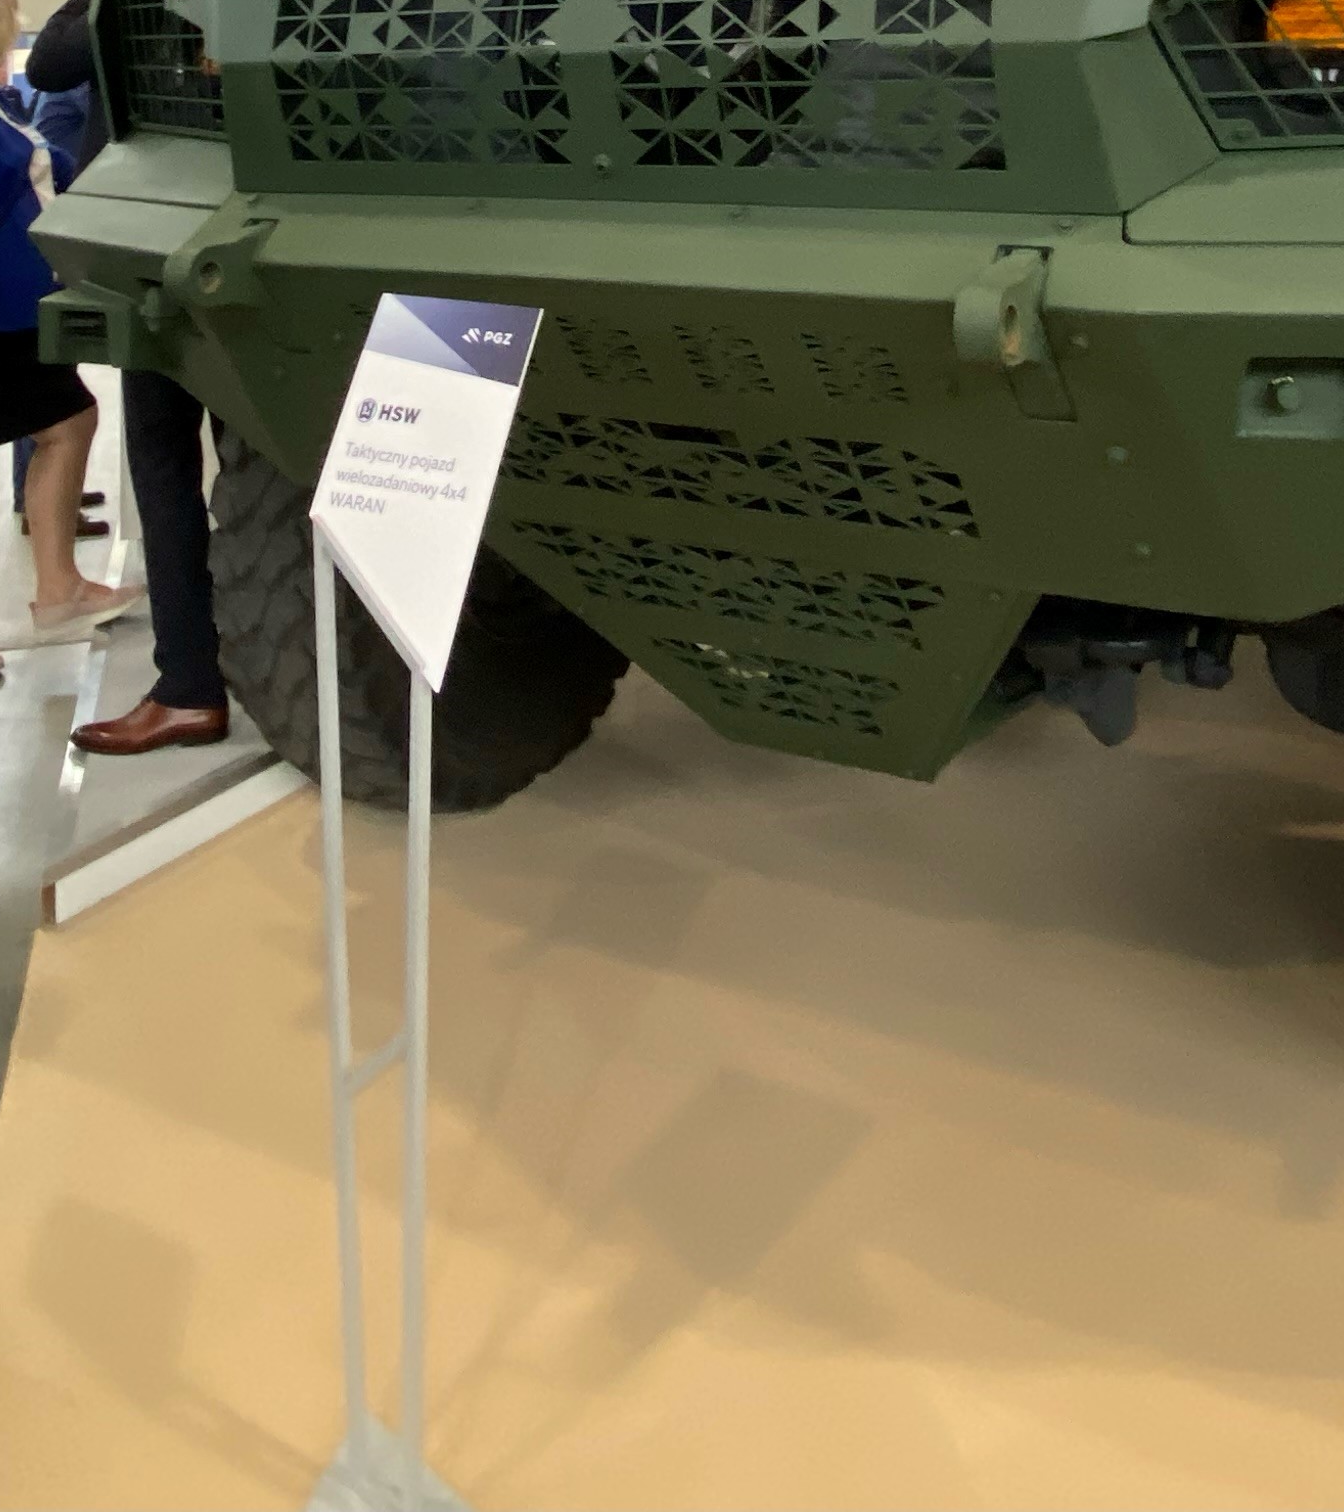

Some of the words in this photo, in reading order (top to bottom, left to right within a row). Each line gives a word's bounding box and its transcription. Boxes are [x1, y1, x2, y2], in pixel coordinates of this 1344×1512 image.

[483, 331, 513, 345] PGZ
[378, 404, 421, 424] HSW
[345, 441, 409, 469] Taktyczny
[408, 456, 457, 472] pojazd
[336, 470, 440, 500] wielozadaniowy
[439, 483, 468, 501] 4x4
[330, 491, 386, 514] WARAN
